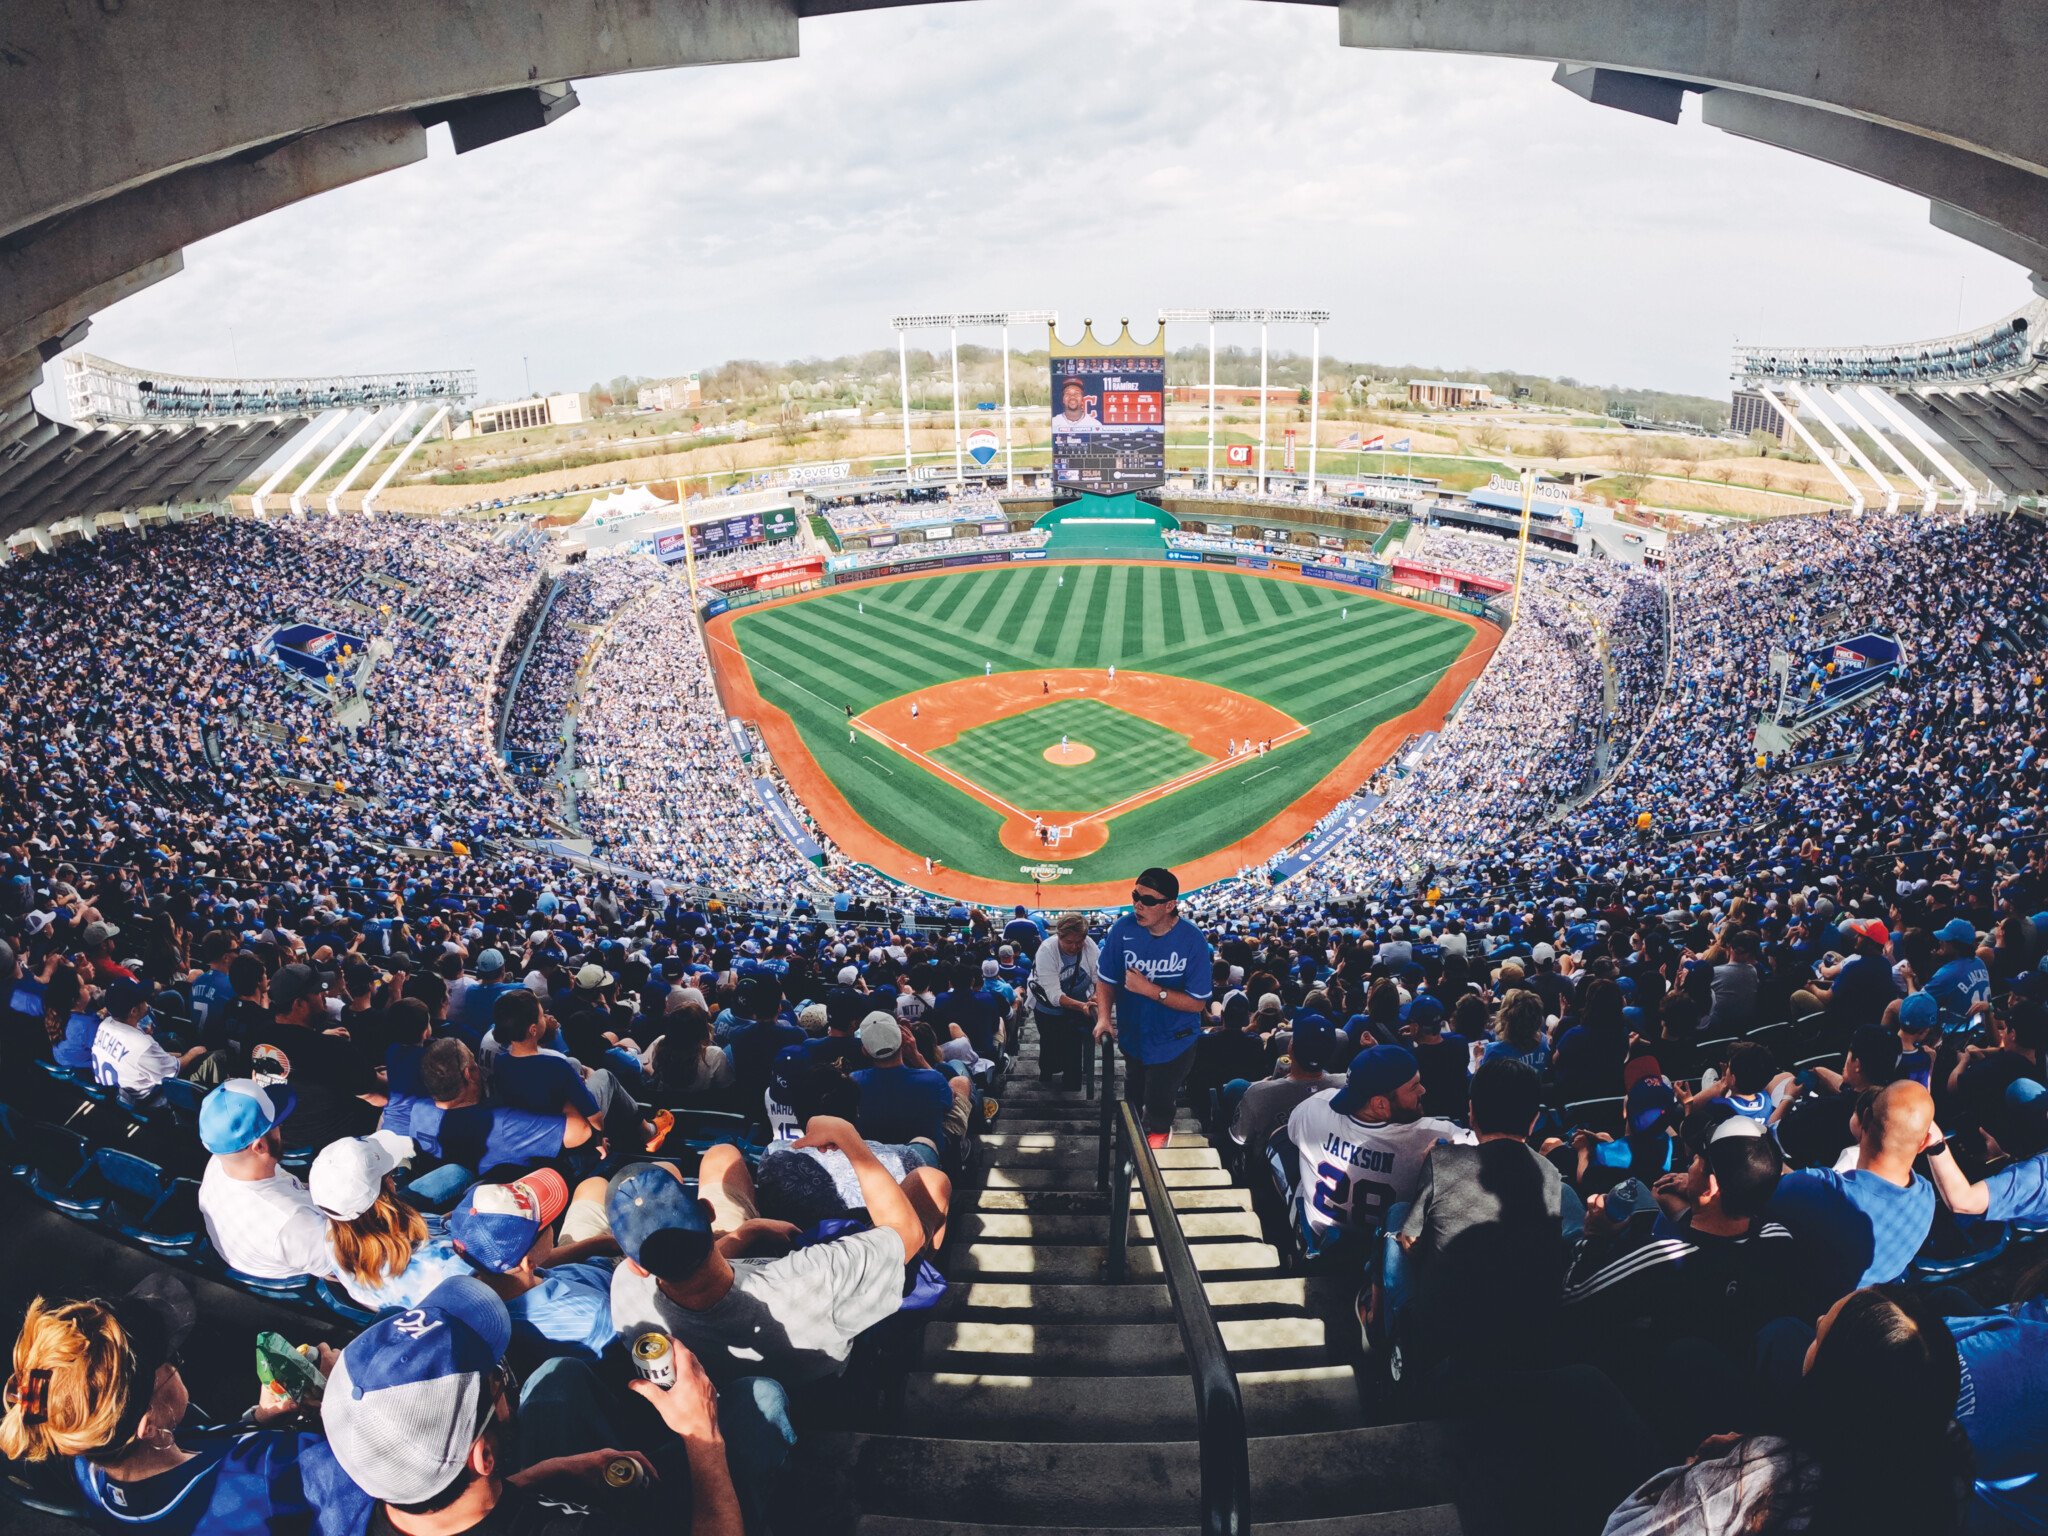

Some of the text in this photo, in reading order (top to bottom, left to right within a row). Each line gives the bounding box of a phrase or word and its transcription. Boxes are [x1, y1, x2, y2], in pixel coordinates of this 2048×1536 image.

[1103, 377, 1112, 391] 11
[1229, 447, 1249, 462] QT
[804, 465, 849, 478] evergy
[1366, 486, 1400, 500] PATIO
[766, 521, 794, 530] Commerce
[660, 536, 675, 546] PRICE
[1836, 650, 1854, 659] PRICE
[1020, 866, 1057, 874] OPENING
[1056, 867, 1074, 875] DAY
[1123, 950, 1188, 981] Royals
[191, 984, 206, 997] WITT
[193, 1001, 209, 1031] 7
[776, 1074, 788, 1089] KC
[777, 1121, 801, 1141] 15
[1323, 1132, 1396, 1174] JACKSON
[1312, 1159, 1398, 1226] 28
[393, 1309, 444, 1340] KC
